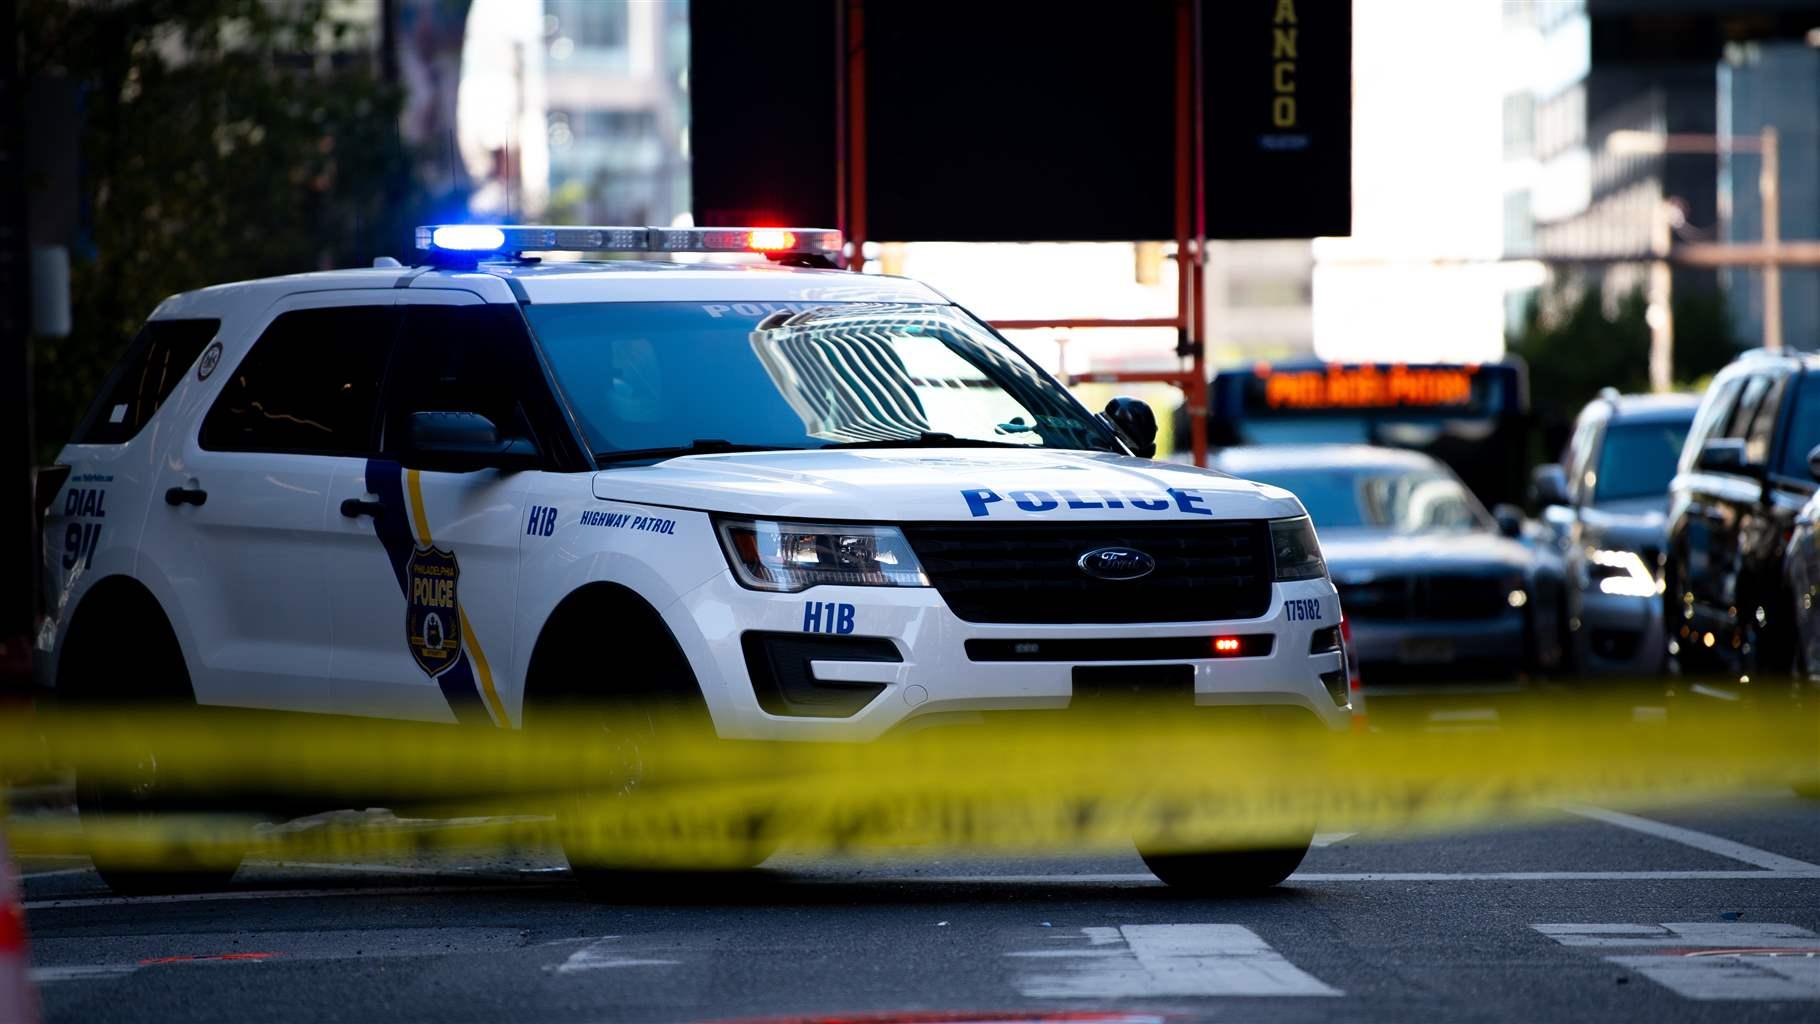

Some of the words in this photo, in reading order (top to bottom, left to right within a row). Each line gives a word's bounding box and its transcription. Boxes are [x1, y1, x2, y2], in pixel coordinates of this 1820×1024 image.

[65, 488, 106, 517] DIAL
[961, 488, 1213, 518] POLICE
[527, 505, 558, 537] H1B
[580, 511, 631, 528] HIGHWAY
[630, 516, 677, 535] PATROL
[62, 522, 102, 570] 911
[413, 577, 454, 608] POLICE
[803, 601, 856, 635] H1B
[1285, 598, 1322, 623] 175182
